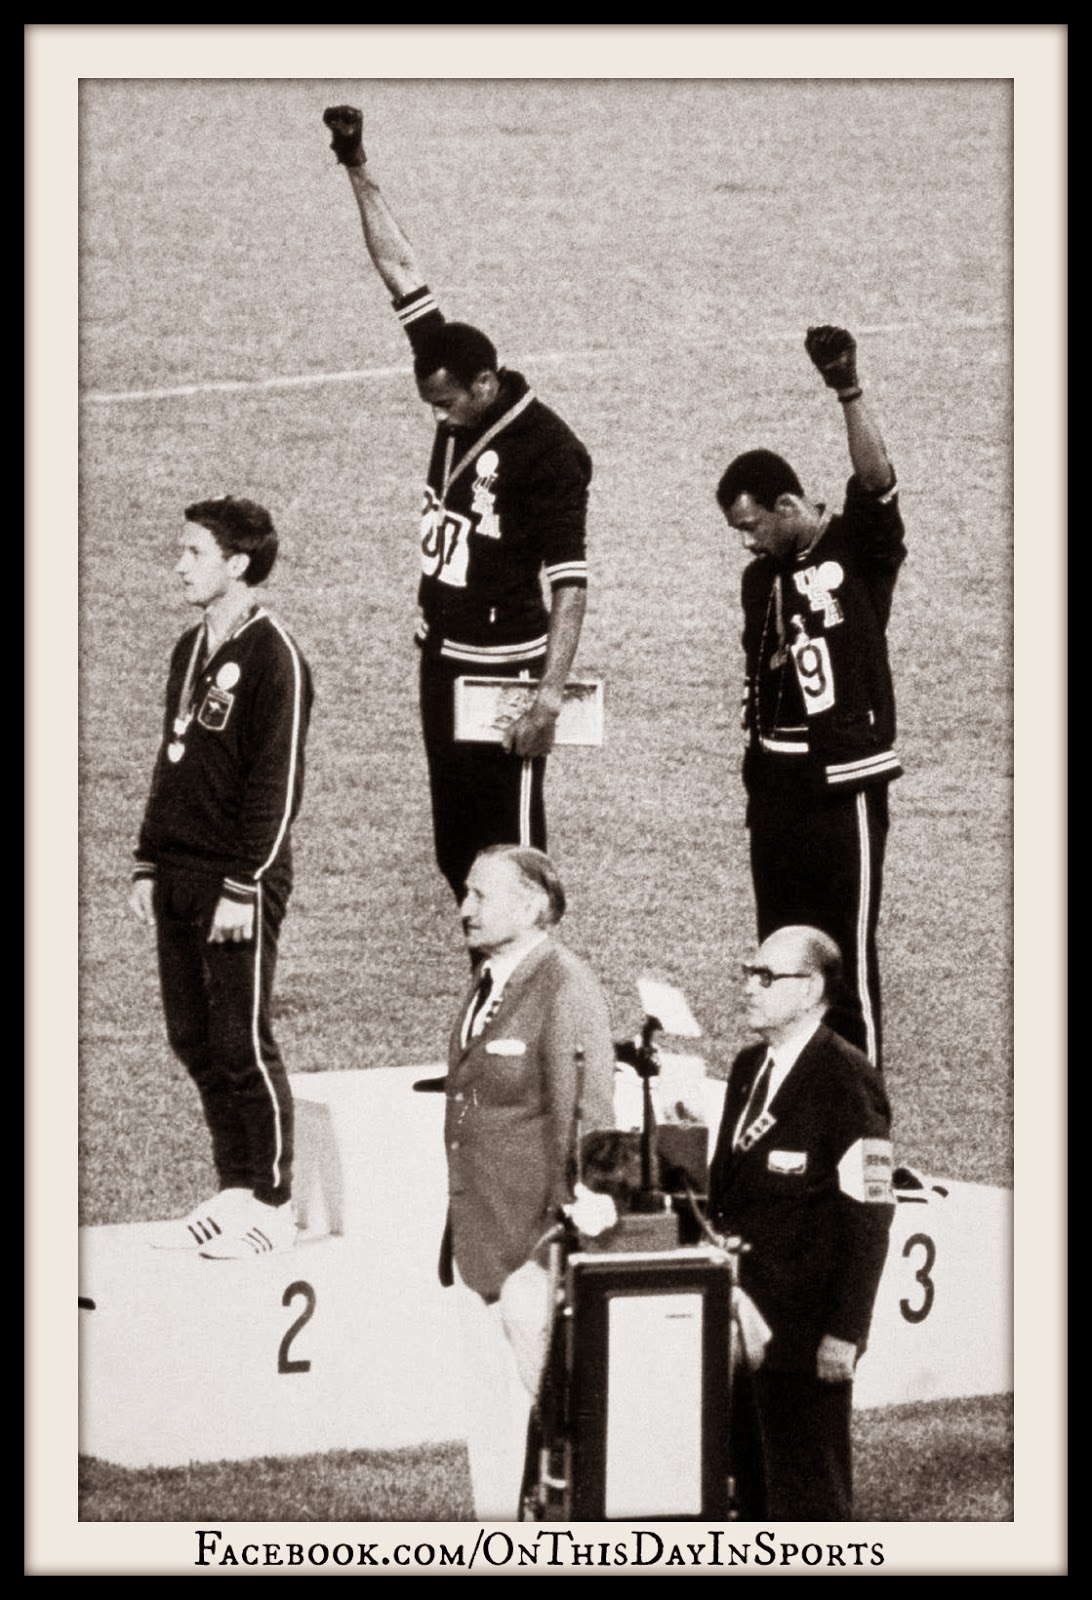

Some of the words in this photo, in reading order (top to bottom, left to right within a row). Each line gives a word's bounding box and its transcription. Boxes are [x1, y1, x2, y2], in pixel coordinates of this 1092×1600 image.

[796, 644, 827, 698] 9
[899, 1233, 936, 1324] 3
[277, 1280, 316, 1374] 2
